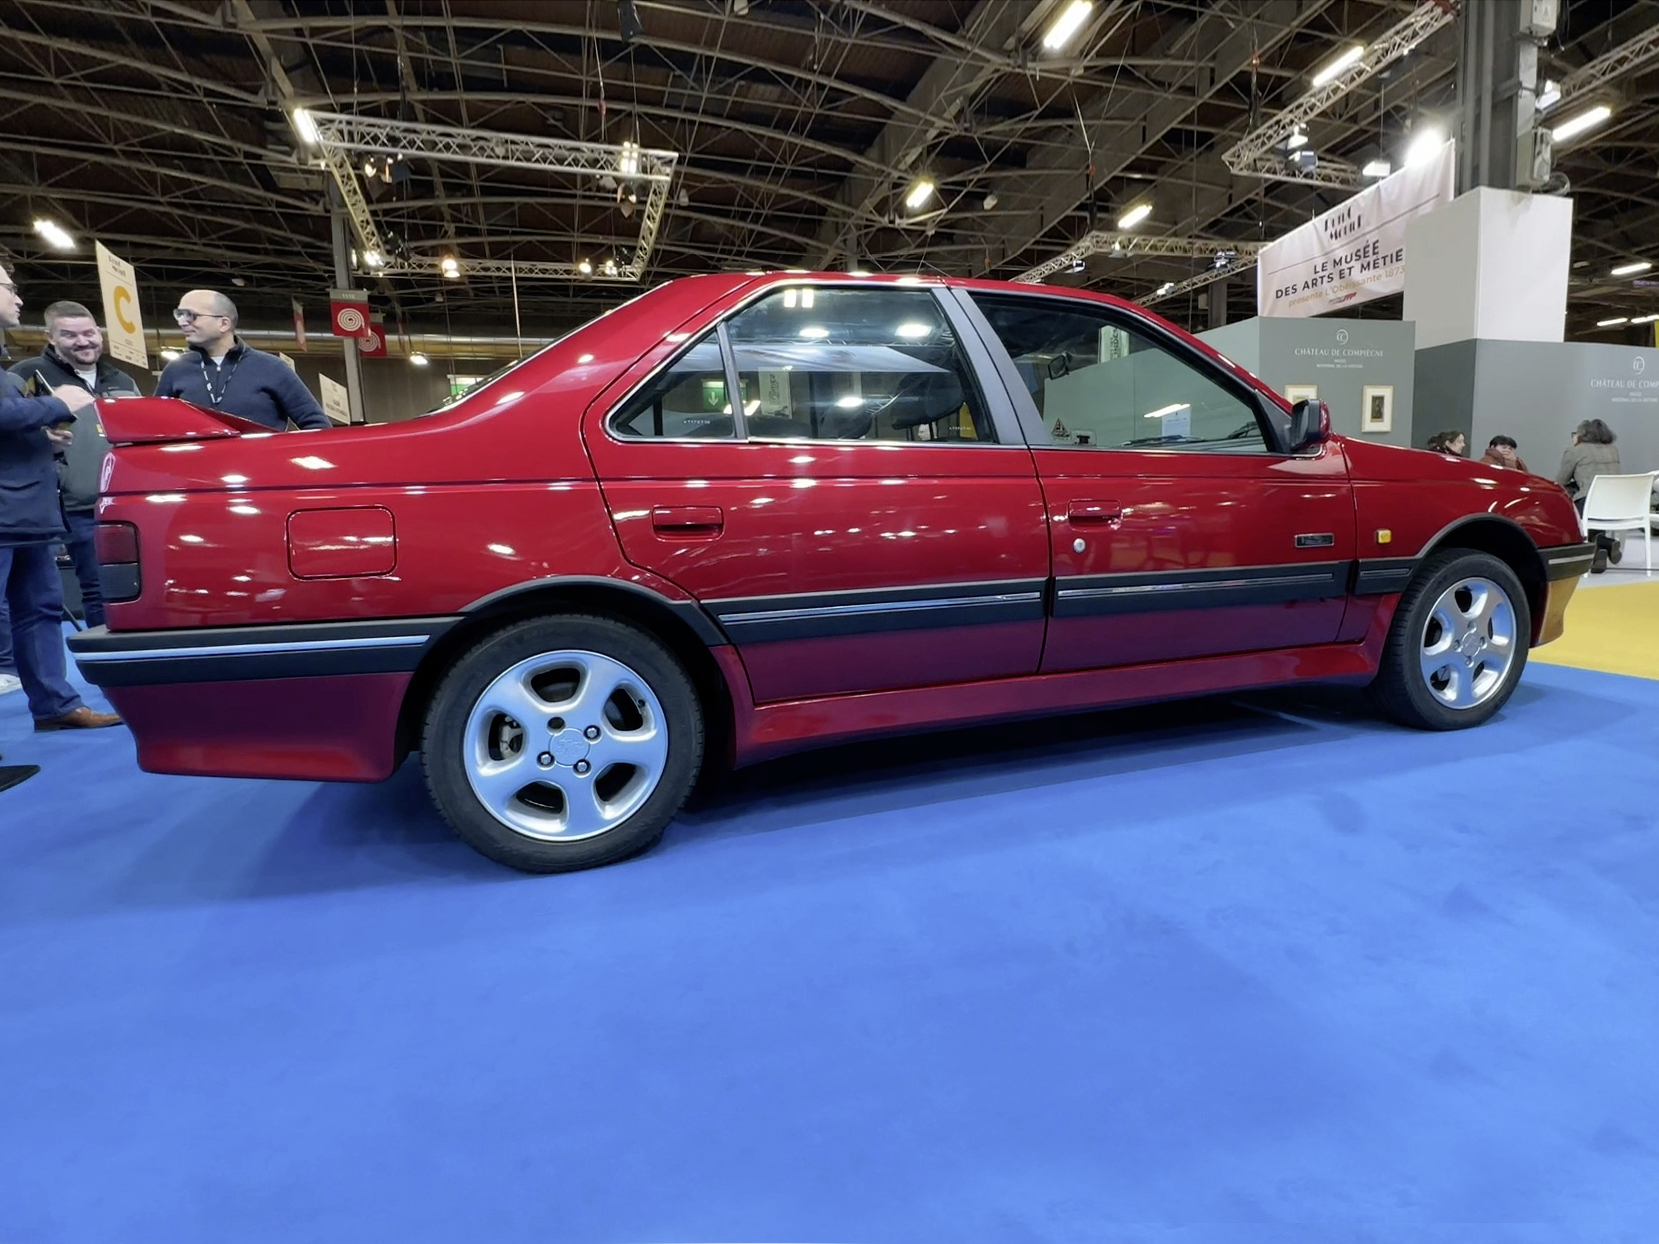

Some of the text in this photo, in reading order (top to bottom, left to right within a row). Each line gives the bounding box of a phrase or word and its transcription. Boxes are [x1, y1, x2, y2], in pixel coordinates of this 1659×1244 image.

[1313, 239, 1379, 275] LE MUSÉE
[1275, 284, 1298, 299] DES
[1302, 272, 1334, 291] ARTS
[1339, 265, 1354, 280] ET
[113, 285, 136, 334] C
[1294, 347, 1329, 356] CHÂTEAU
[1331, 348, 1340, 356] DE
[1590, 378, 1624, 388] CHÂTEAU
[1627, 379, 1636, 388] DE
